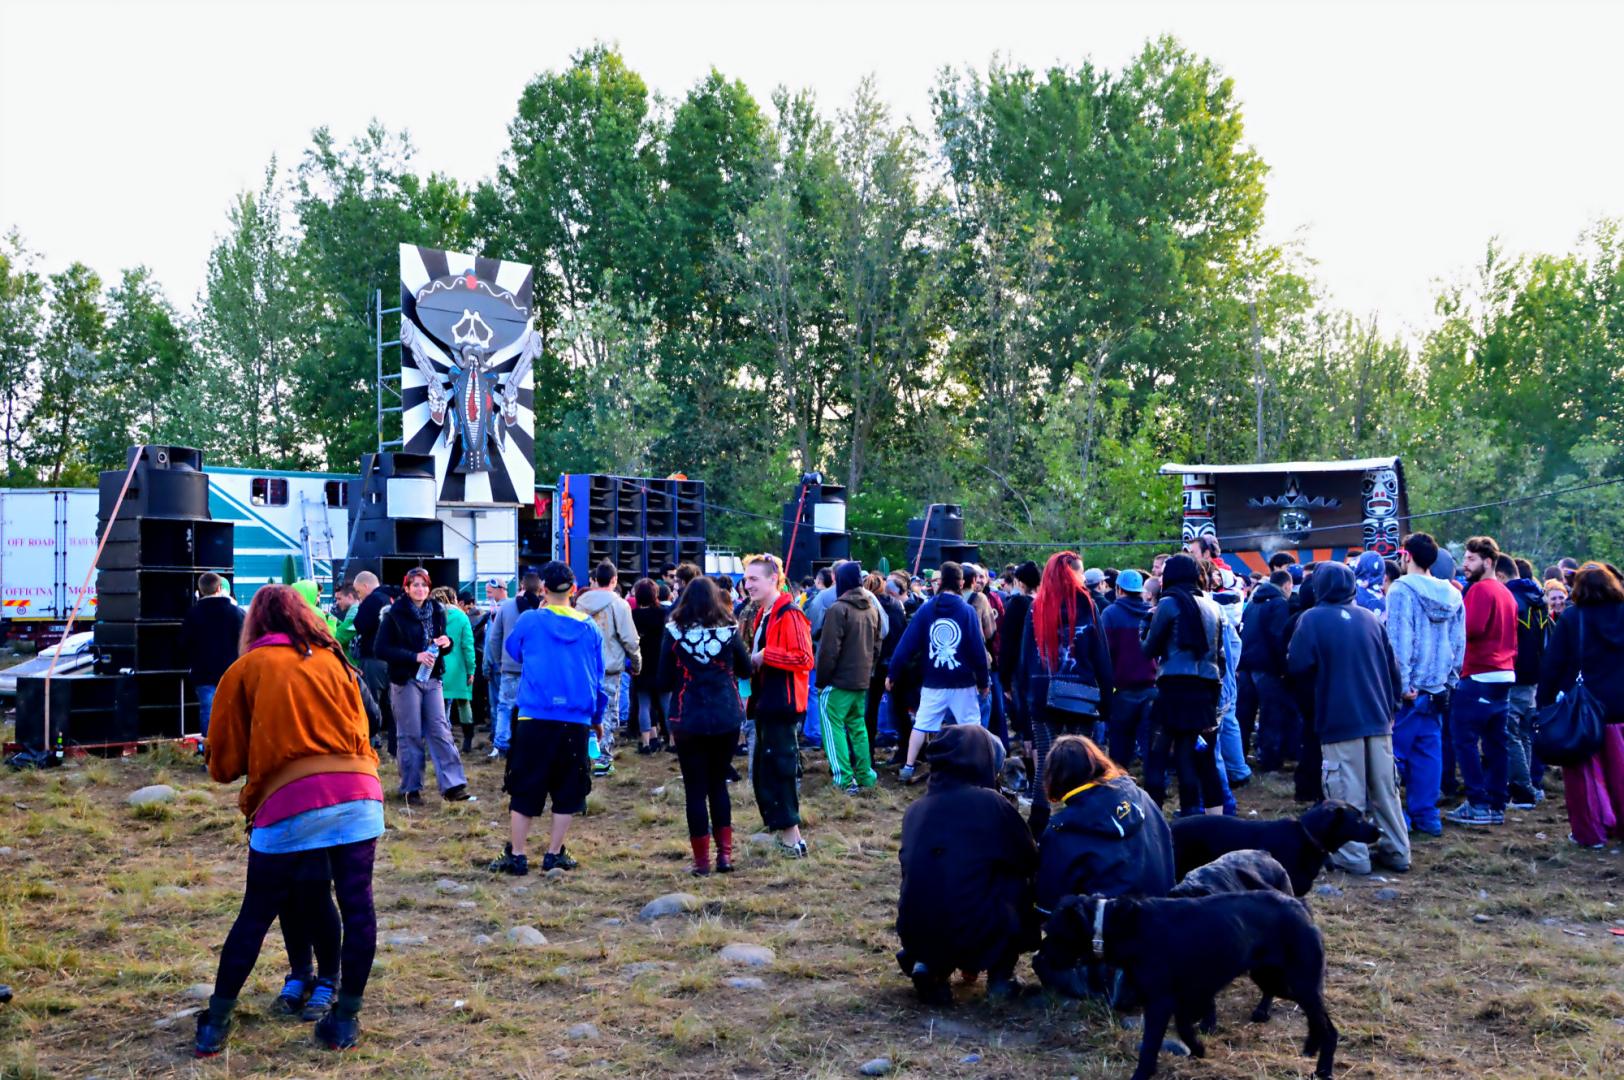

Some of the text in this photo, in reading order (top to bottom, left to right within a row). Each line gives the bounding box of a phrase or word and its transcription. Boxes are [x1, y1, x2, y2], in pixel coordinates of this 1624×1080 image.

[7, 538, 24, 547] OFF
[28, 538, 55, 546] ROAD
[5, 588, 53, 597] OFFICINA
